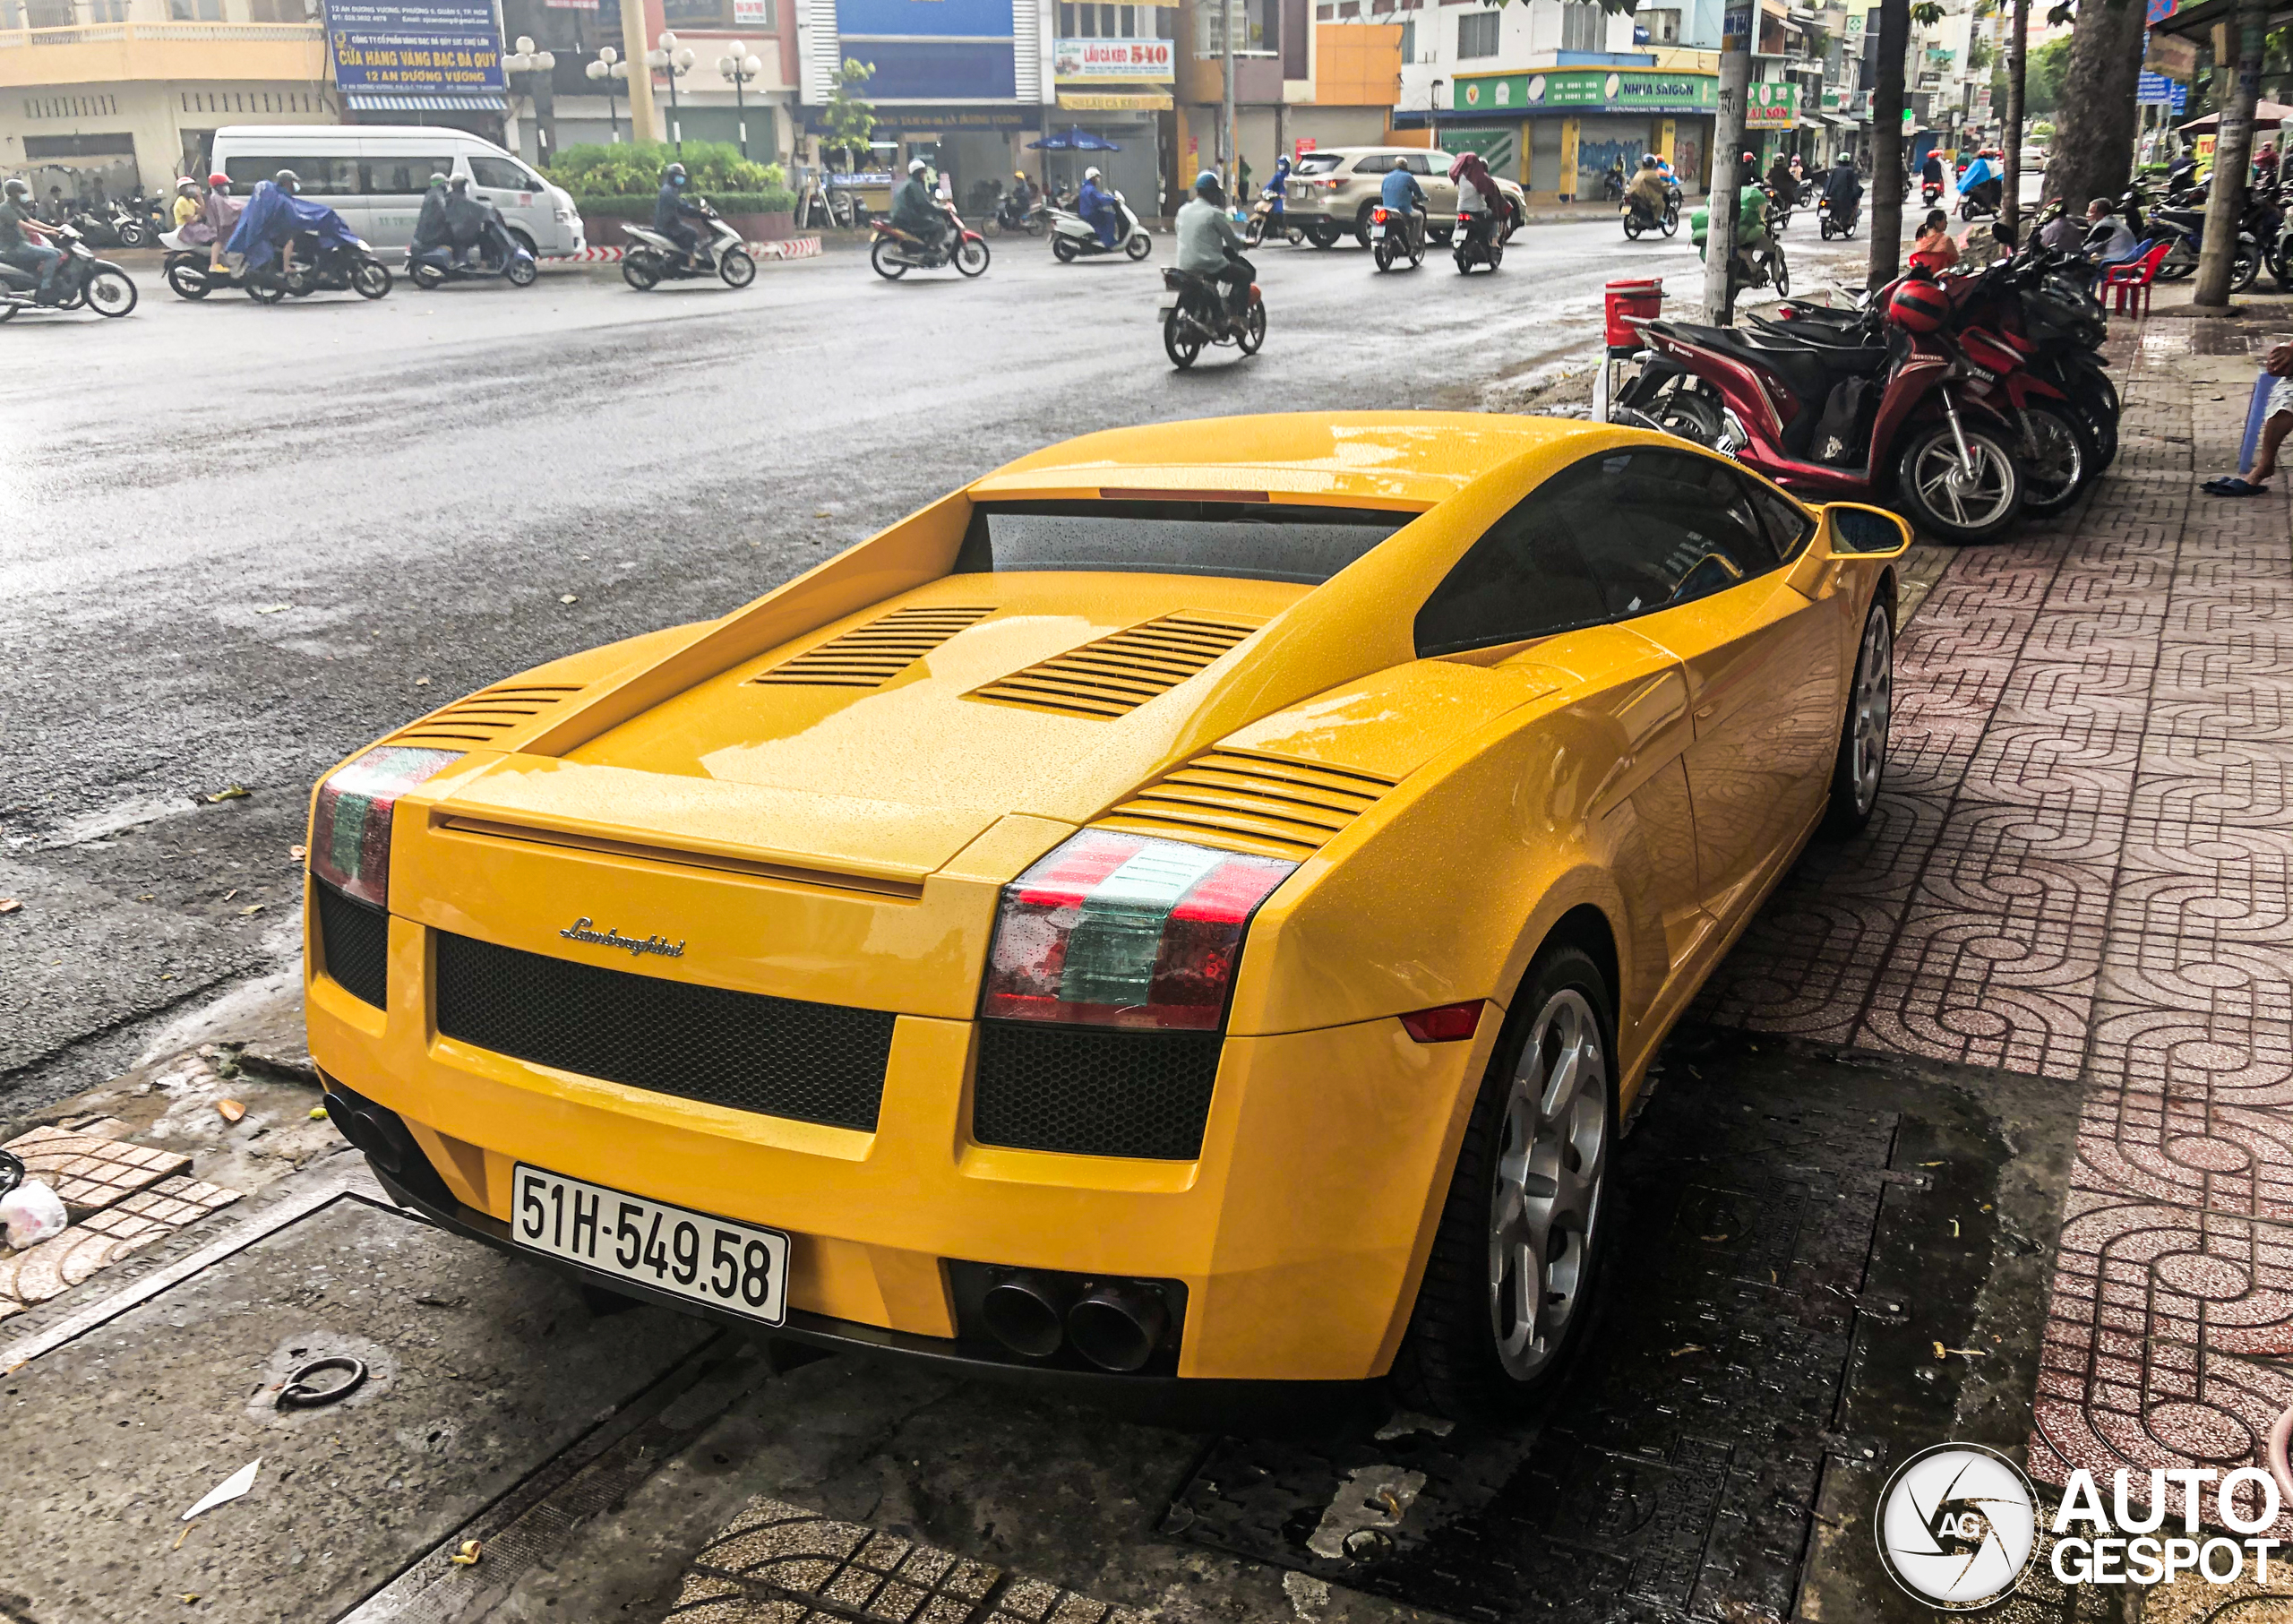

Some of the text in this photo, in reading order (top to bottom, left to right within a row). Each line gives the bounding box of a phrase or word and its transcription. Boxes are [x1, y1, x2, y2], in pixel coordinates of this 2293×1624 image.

[339, 47, 496, 69] CỬA HÀNG VÀNG BẠC ĐÁ QUÝ
[1084, 43, 1099, 63] LẨU
[1100, 46, 1111, 63] CÁ
[1112, 46, 1128, 63] KÈO
[1130, 44, 1168, 64] 540
[365, 69, 485, 82] 12 AN DƯƠNG VƯƠNG
[1623, 83, 1653, 96] NHỰA
[1747, 101, 1762, 118] ẢI
[1911, 354, 1944, 362] HONDA
[559, 916, 685, 957] Lamborghini
[522, 1174, 771, 1308] 51H-549.58
